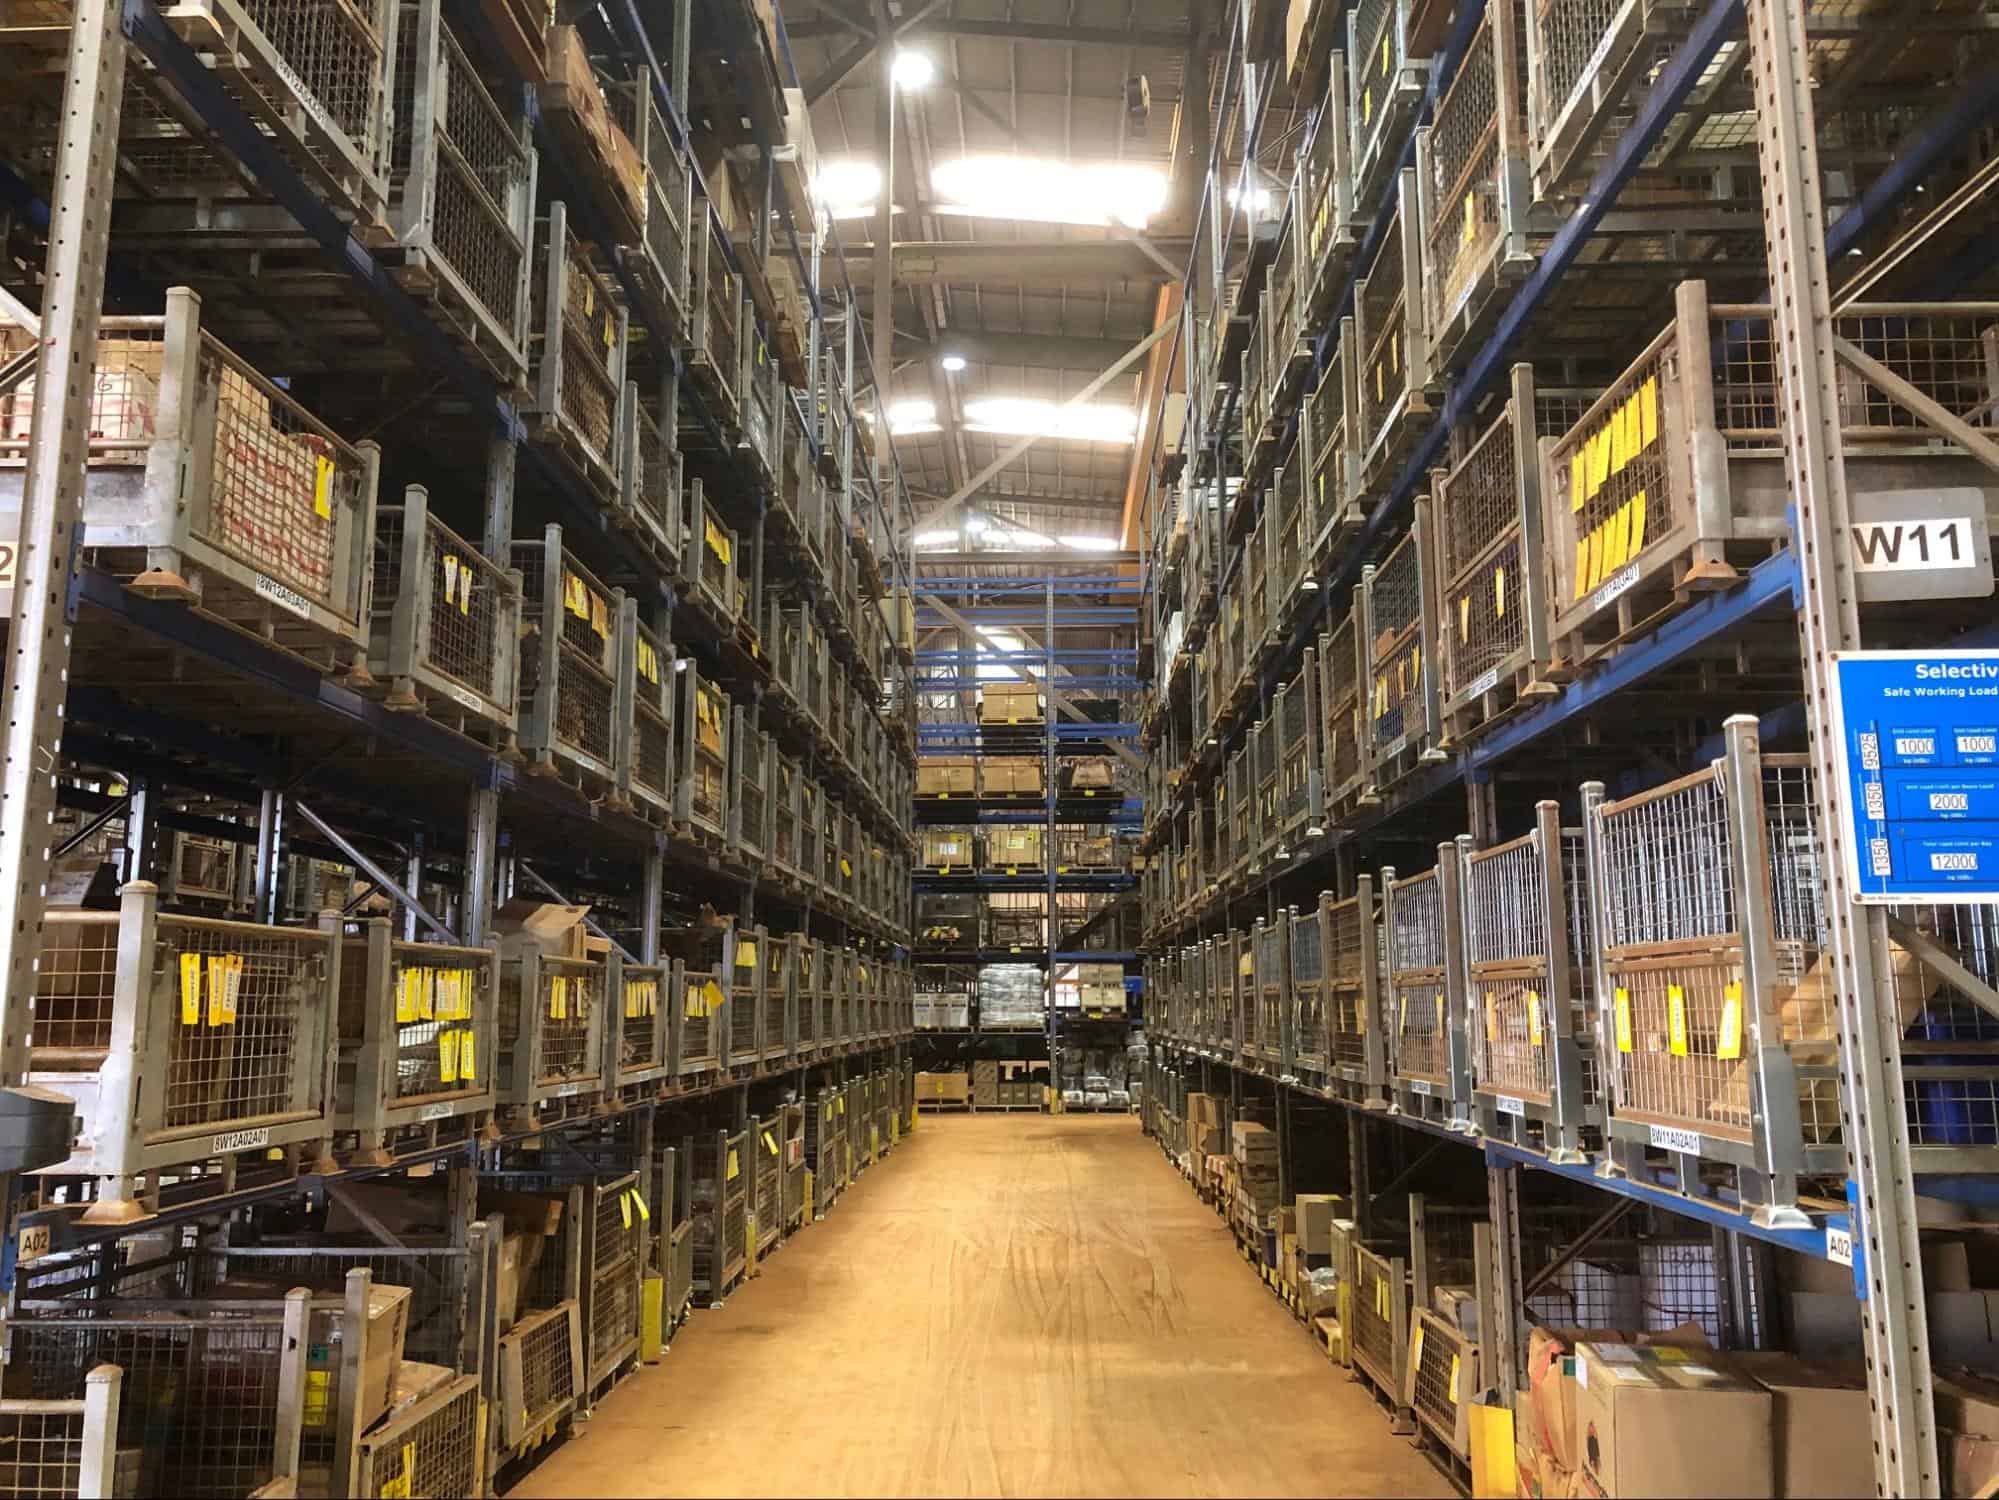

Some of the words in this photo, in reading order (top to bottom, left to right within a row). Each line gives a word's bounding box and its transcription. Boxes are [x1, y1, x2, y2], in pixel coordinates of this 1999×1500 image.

[1851, 523, 1961, 564] W11
[1915, 663, 1999, 679] Selectiv
[1883, 687, 1911, 697] Safe
[1914, 687, 1966, 698] Working
[1969, 685, 1999, 696] Load
[1861, 734, 1878, 767] 9525
[1901, 739, 1934, 753] 1000
[1962, 737, 1995, 751] 1000
[1866, 784, 1884, 816] 1350
[1934, 795, 1968, 809] 2000
[1872, 840, 1889, 871] 1350
[1935, 855, 1977, 869] 12000
[23, 1231, 48, 1254] A02
[1830, 1235, 1851, 1258] A02
